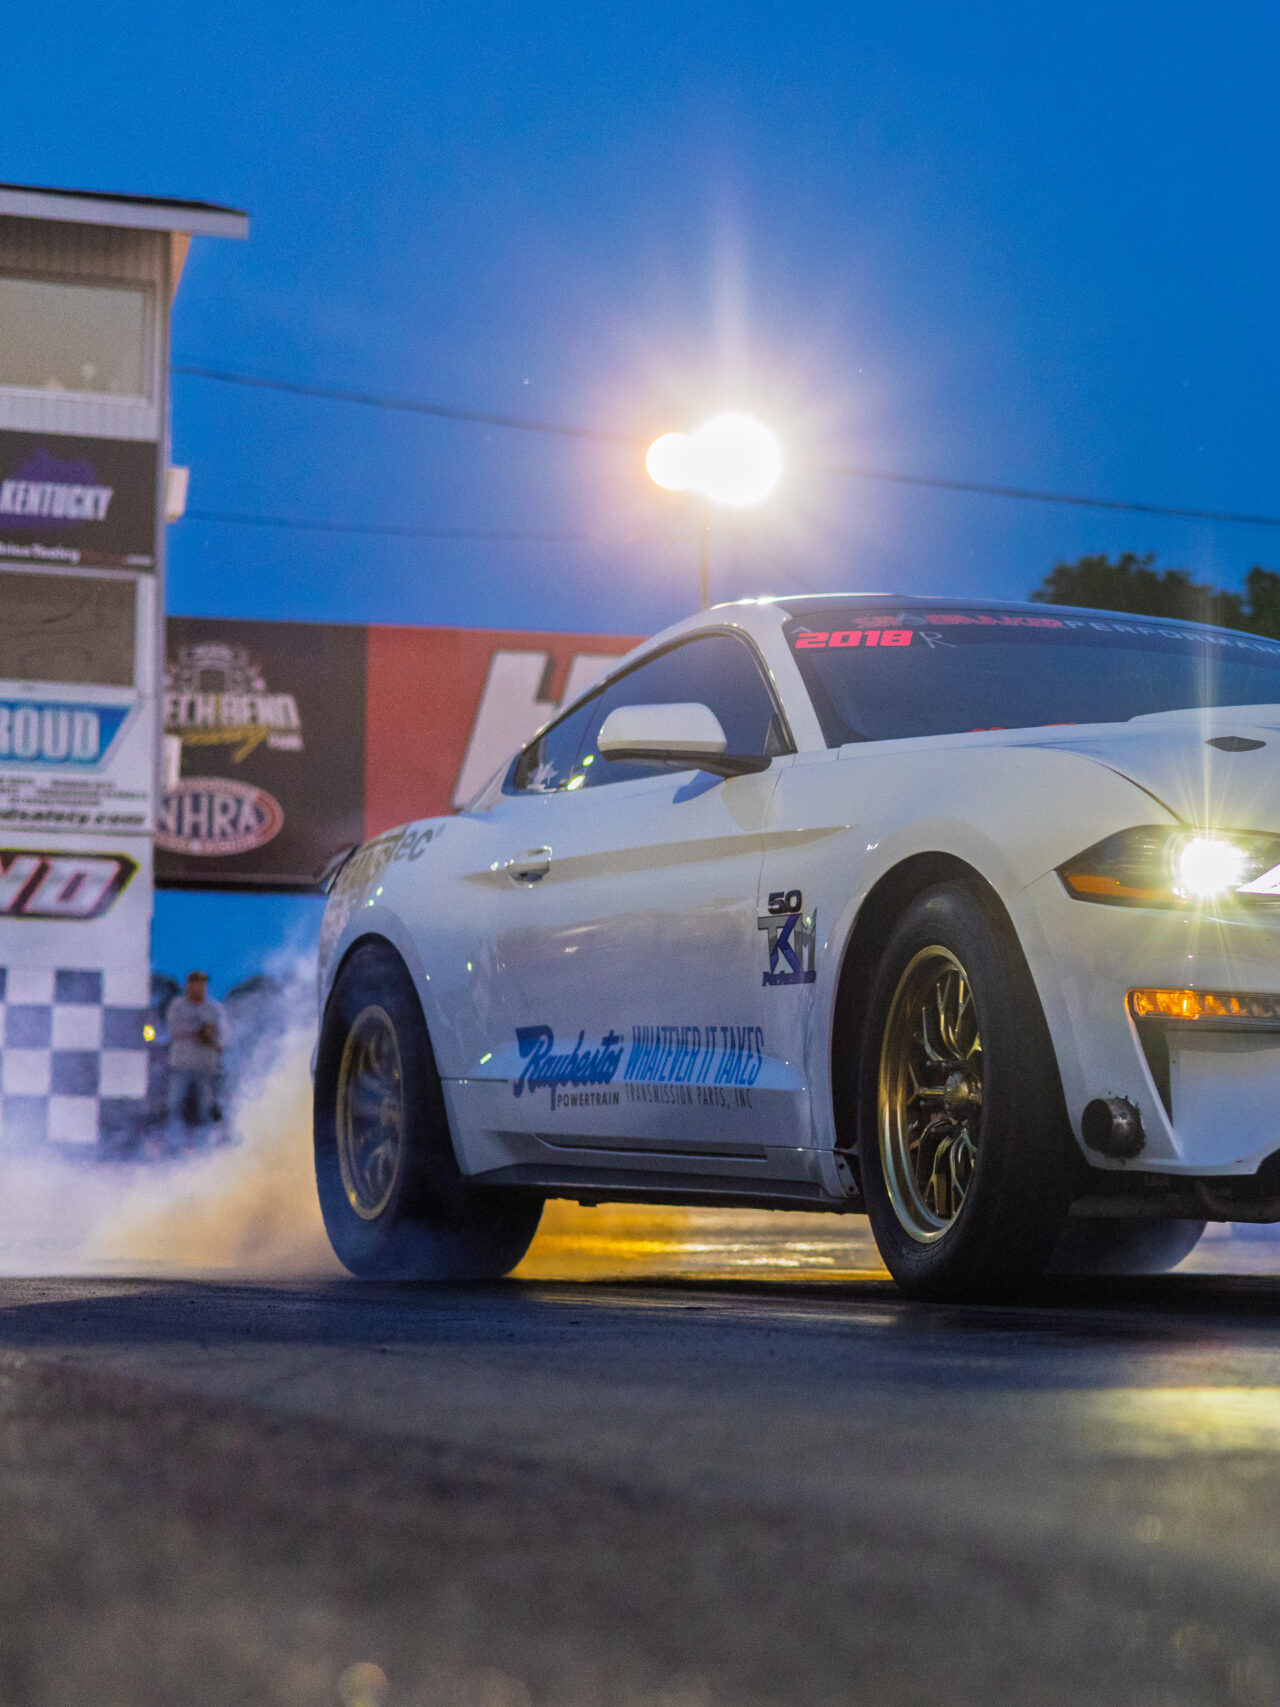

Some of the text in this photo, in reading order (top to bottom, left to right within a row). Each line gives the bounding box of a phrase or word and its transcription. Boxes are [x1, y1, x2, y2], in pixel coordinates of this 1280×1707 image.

[795, 630, 913, 648] 2018
[624, 1025, 764, 1086] WHATEVER IT TAKES
[557, 1092, 620, 1108] POWERTRAIN
